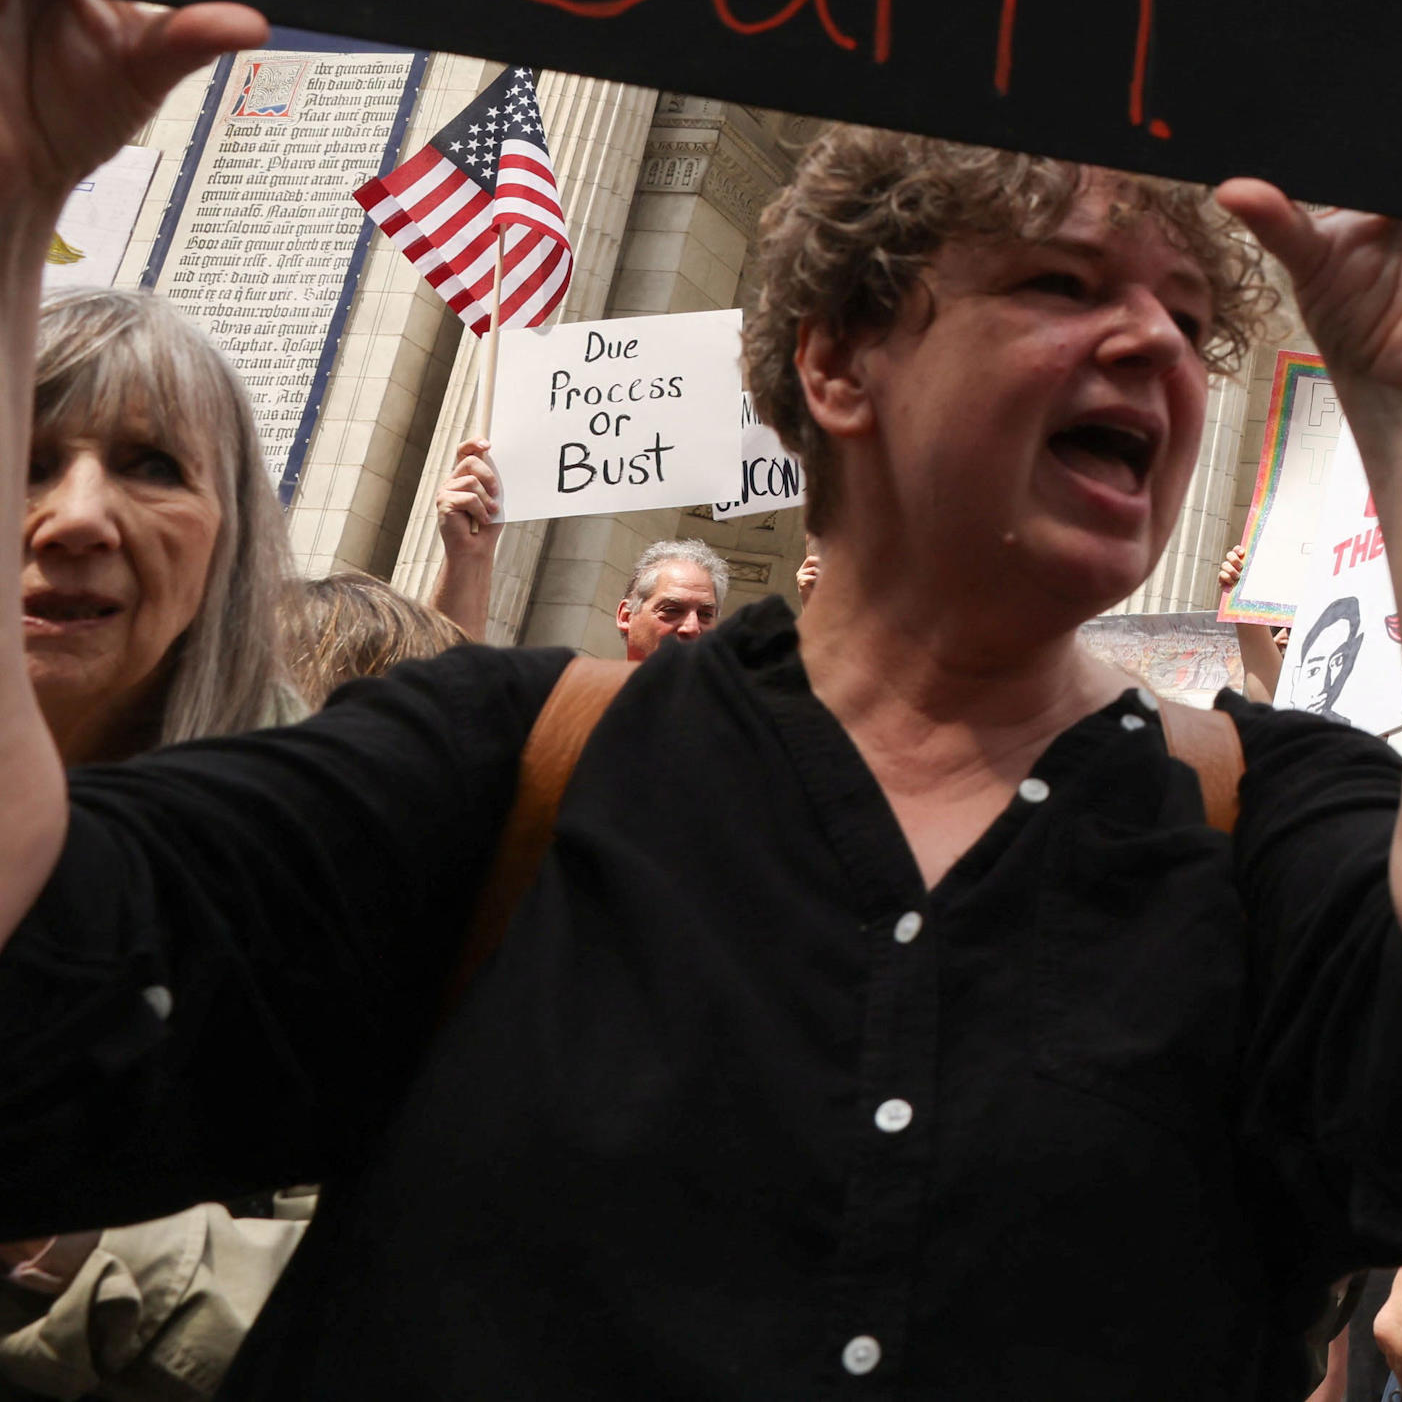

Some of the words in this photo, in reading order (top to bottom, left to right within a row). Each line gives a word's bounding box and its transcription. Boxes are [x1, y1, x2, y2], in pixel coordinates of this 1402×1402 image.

[585, 331, 639, 363] Due
[550, 370, 684, 412] Process
[589, 412, 631, 437] or
[557, 432, 676, 494] Bust
